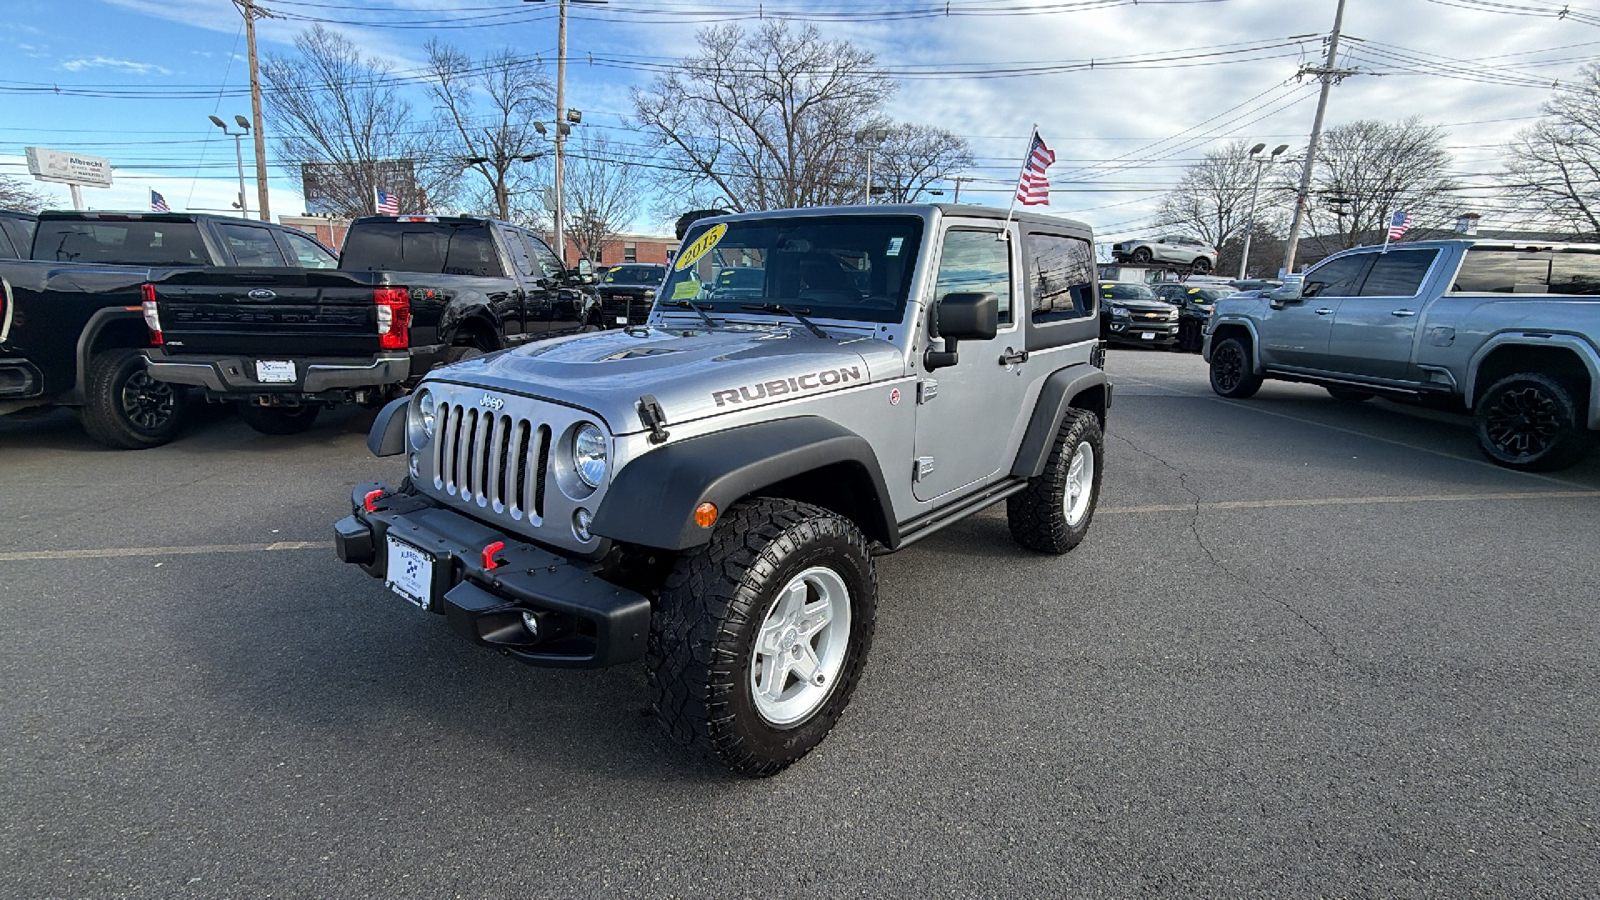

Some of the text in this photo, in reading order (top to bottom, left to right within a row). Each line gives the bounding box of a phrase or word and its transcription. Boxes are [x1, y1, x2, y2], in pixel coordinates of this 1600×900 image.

[684, 228, 718, 266] 2015
[479, 392, 505, 411] Jeep
[711, 365, 861, 407] RUBICON
